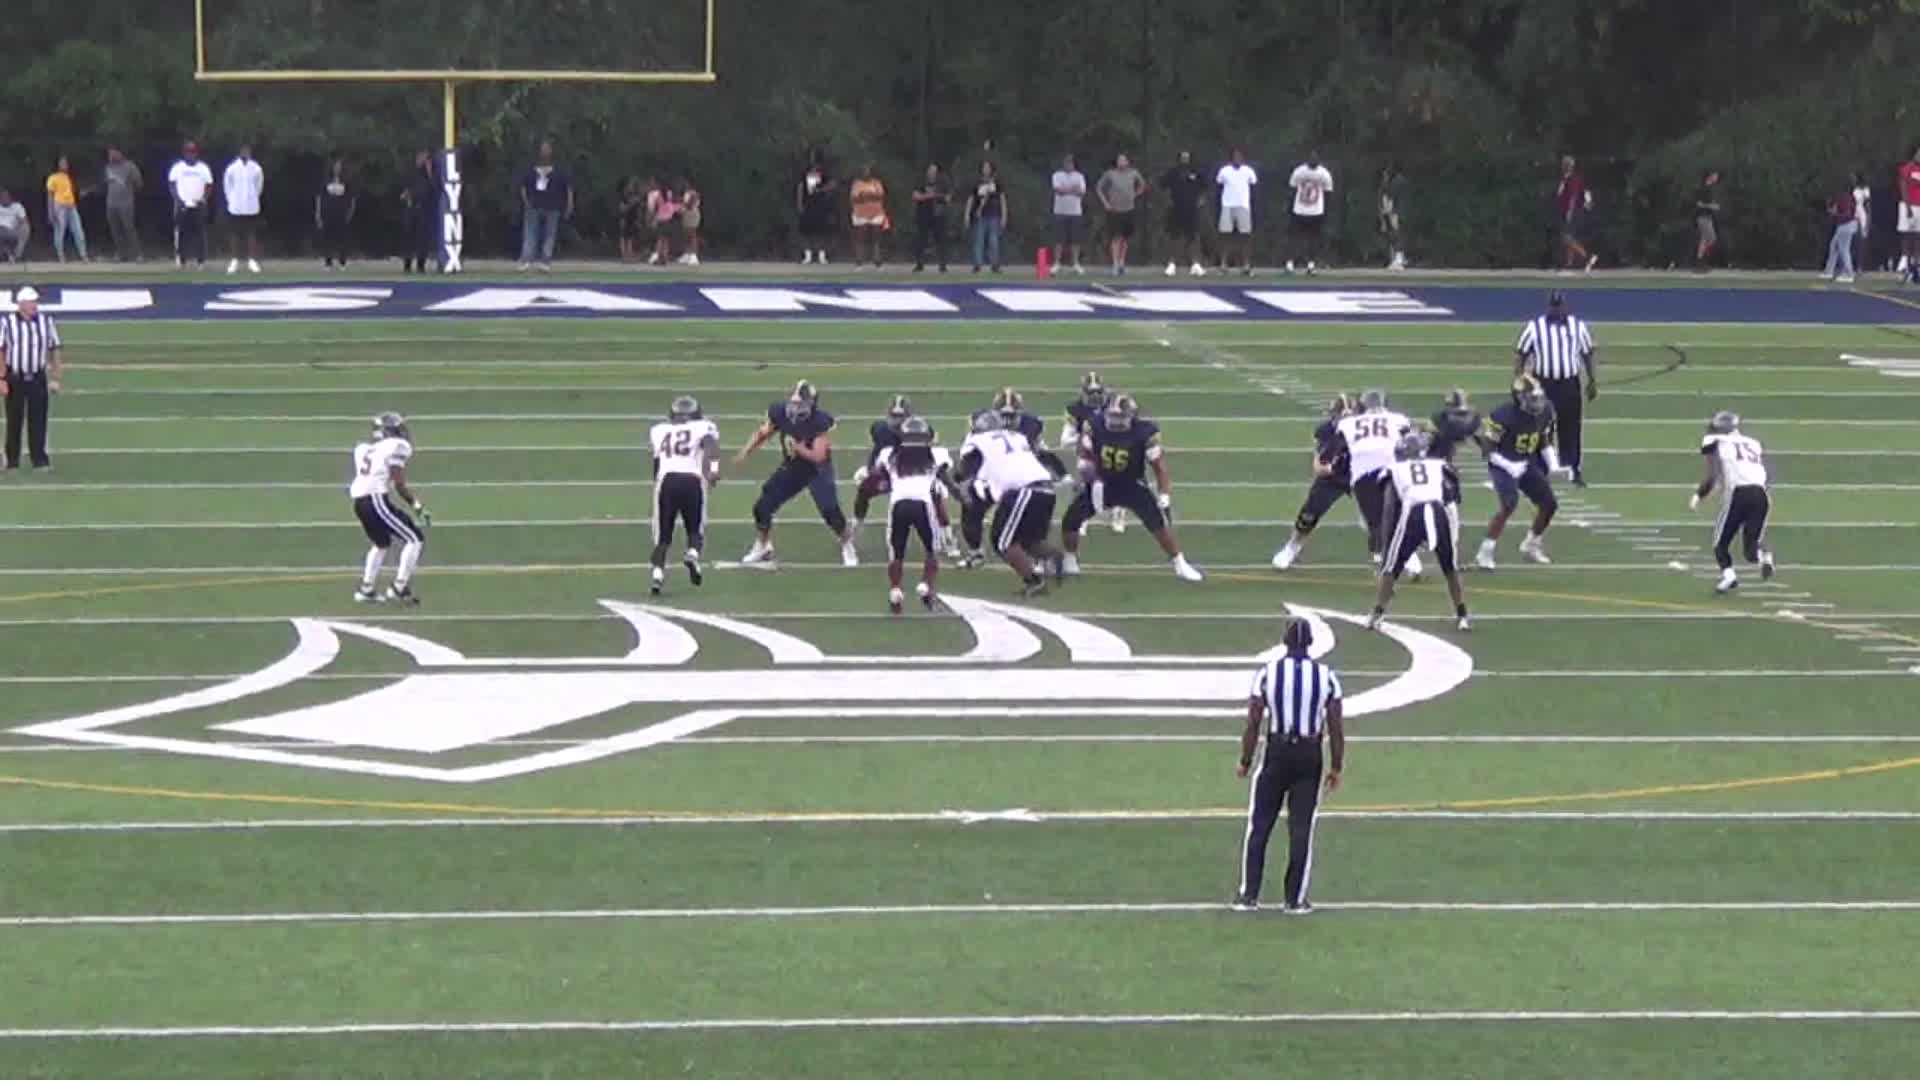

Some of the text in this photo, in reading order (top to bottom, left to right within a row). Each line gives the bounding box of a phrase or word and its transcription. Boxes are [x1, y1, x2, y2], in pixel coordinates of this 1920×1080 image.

[444, 152, 463, 273] LYNX
[660, 430, 691, 458] 42
[360, 447, 376, 476] 5
[1410, 463, 1429, 485] 8
